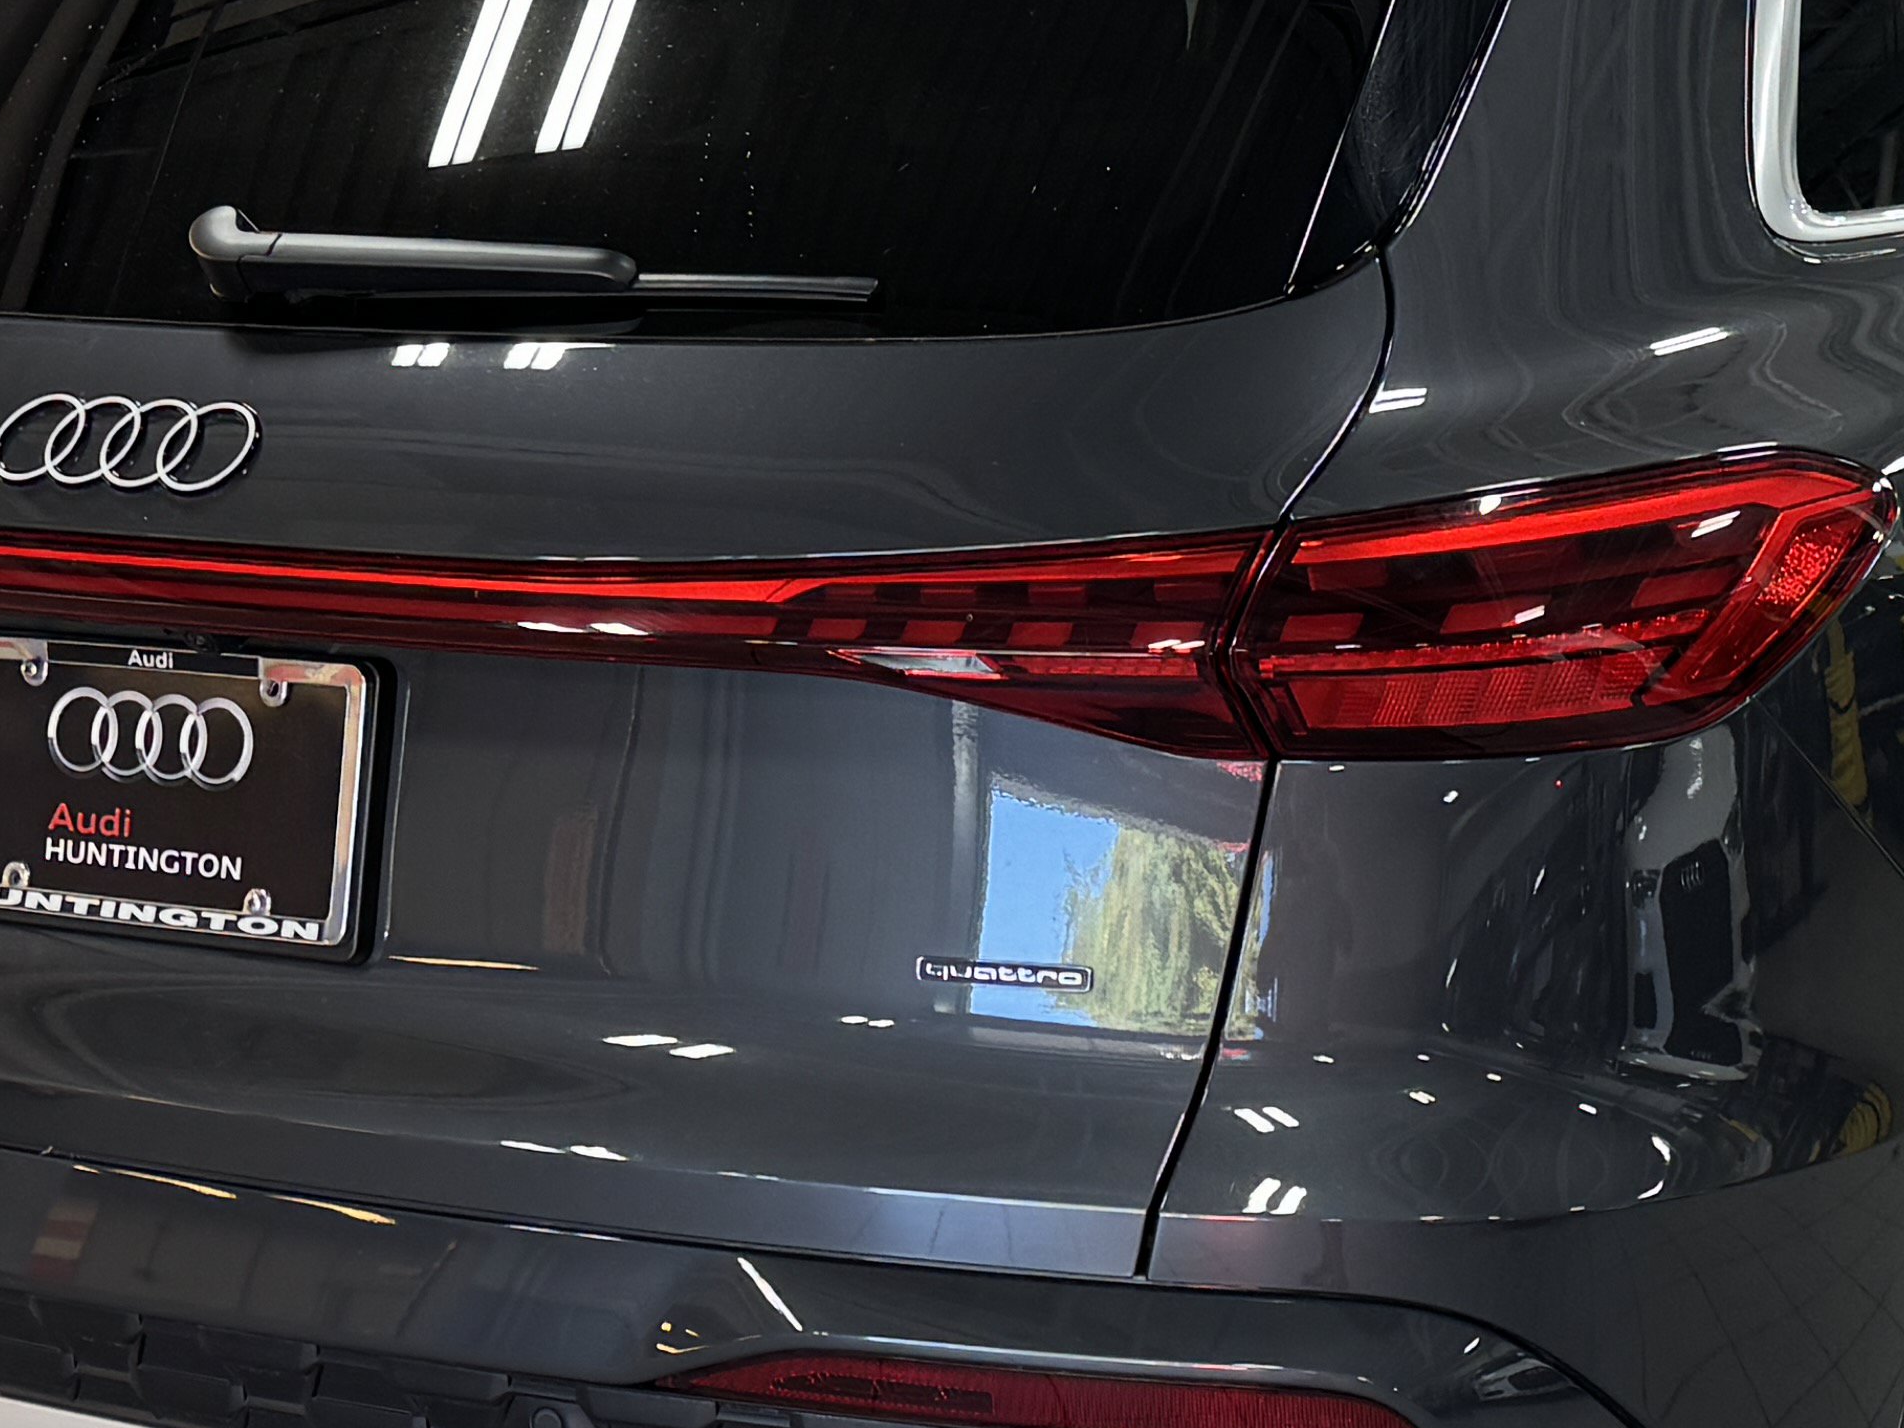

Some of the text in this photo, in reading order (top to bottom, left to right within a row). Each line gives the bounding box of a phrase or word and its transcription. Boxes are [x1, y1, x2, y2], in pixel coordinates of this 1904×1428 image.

[128, 648, 175, 670] Audi
[48, 802, 133, 838] Audi
[44, 837, 242, 882] HUNTINGTON
[925, 962, 1083, 985] quattro
